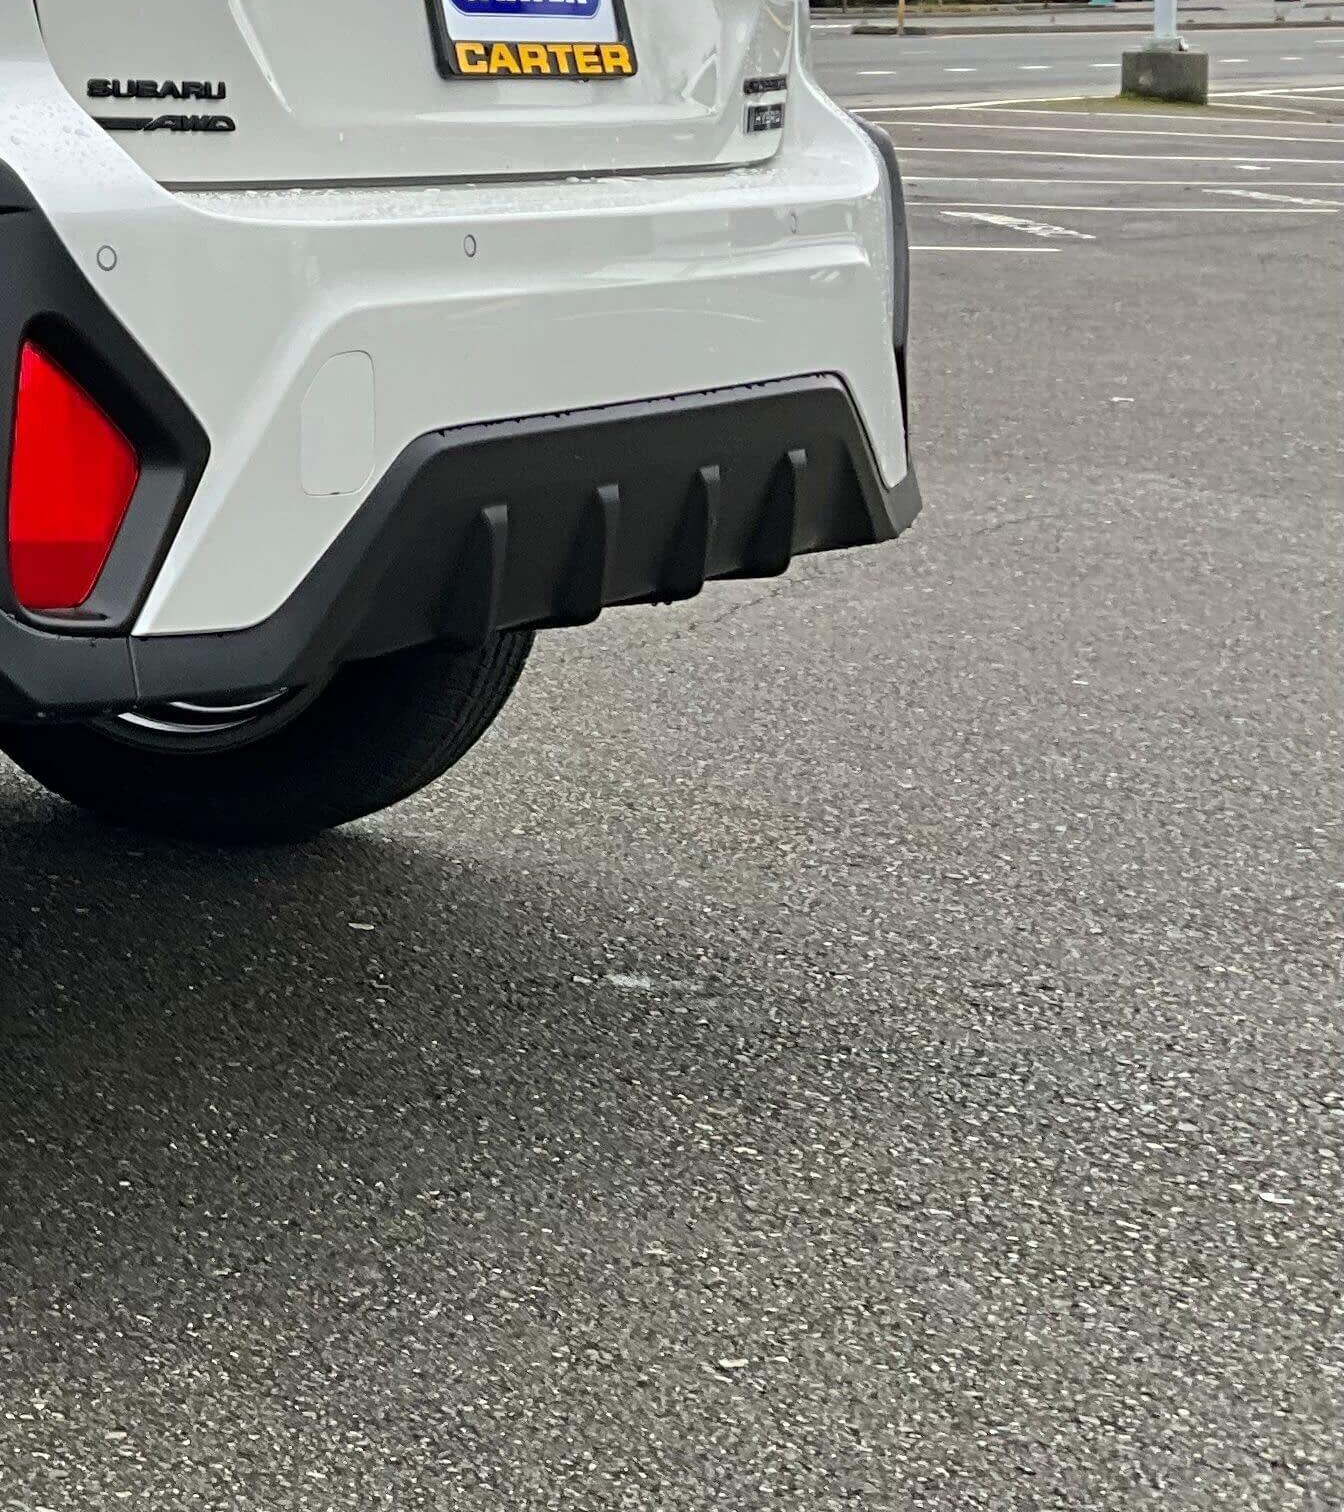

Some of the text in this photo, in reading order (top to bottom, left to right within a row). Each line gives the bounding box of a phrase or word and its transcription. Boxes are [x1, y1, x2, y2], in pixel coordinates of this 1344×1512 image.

[455, 42, 633, 75] CARTER
[86, 78, 227, 99] SUBARU
[143, 115, 236, 132] AWD
